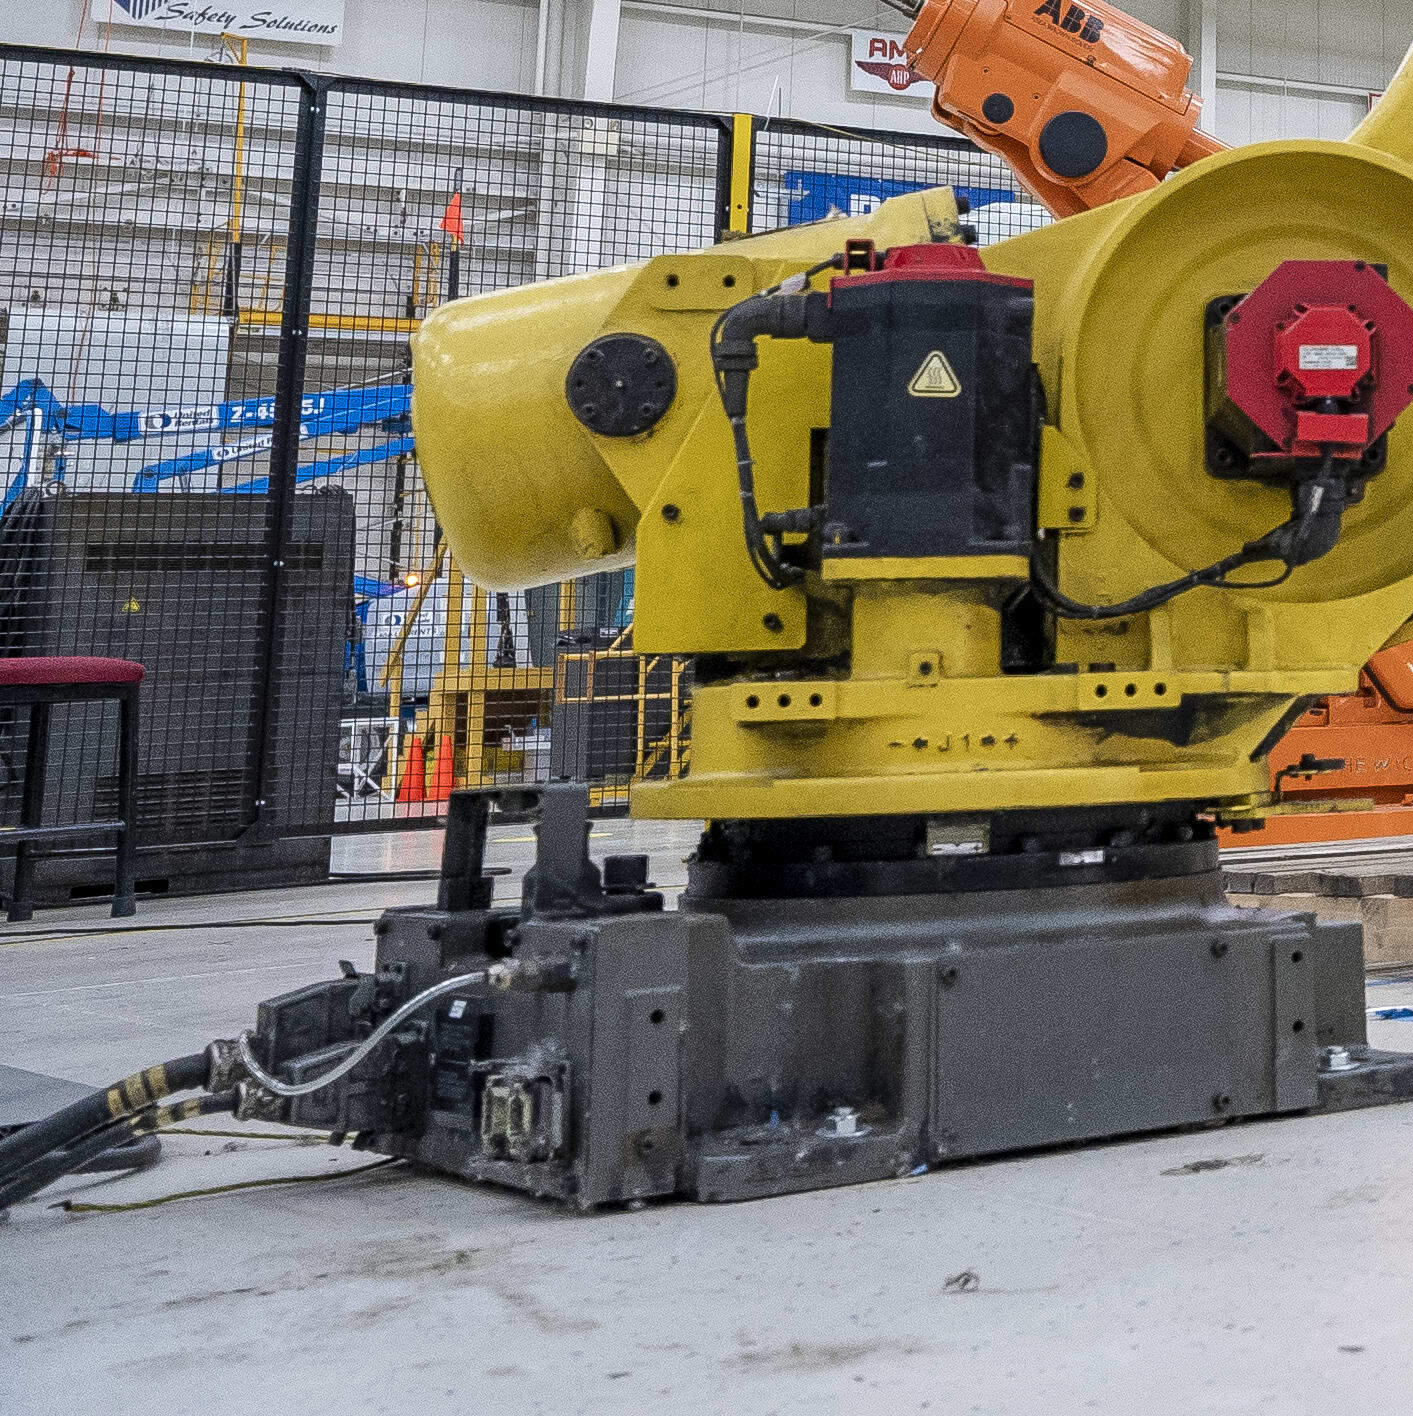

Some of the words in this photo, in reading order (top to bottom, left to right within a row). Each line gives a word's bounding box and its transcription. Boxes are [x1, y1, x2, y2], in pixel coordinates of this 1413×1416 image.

[154, 2, 237, 29] Safety
[238, 11, 338, 34] Solutions
[869, 37, 906, 60] AM
